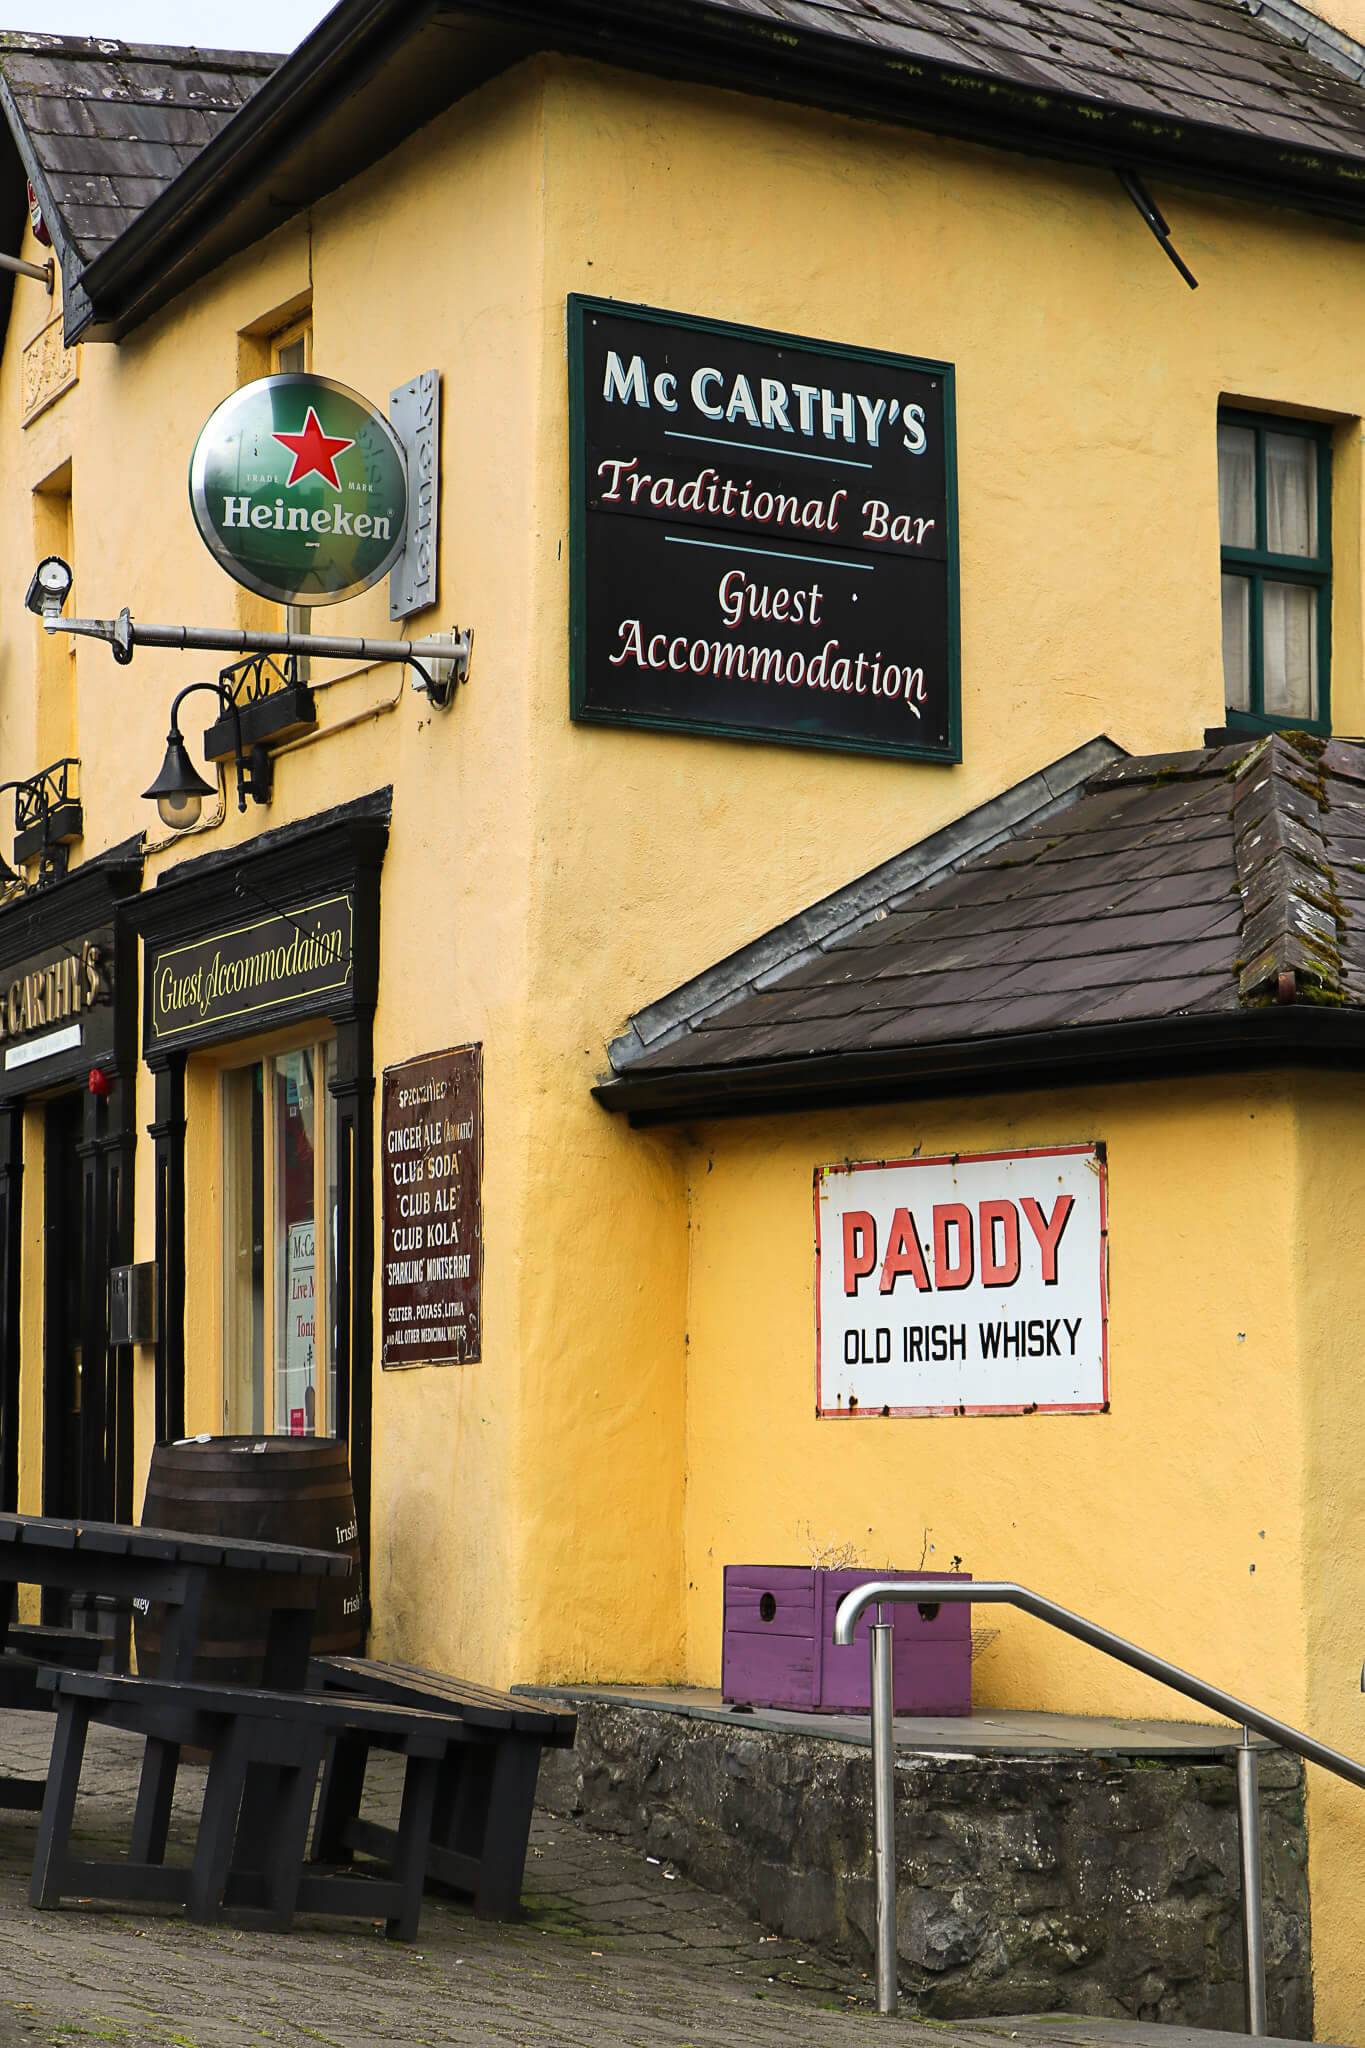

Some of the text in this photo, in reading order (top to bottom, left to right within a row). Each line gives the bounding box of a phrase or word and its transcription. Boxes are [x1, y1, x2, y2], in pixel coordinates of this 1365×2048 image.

[603, 351, 927, 454] Mc CARTHY'S
[247, 474, 374, 492] TRADE MARK
[597, 458, 935, 544] Traditional Bar
[222, 496, 392, 541] Heineken
[719, 570, 823, 628] Guest
[609, 620, 928, 702] Accommodation
[160, 921, 342, 1016] Guest Accommodation
[388, 1125, 421, 1153] GINGER
[423, 1122, 442, 1147] ALE
[427, 1254, 471, 1282] MONTSERRAT
[842, 1195, 1076, 1297] PADDY
[292, 1277, 308, 1300] Live
[395, 1330, 404, 1345] ALL
[404, 1328, 420, 1344] OTHER
[421, 1327, 447, 1342] MEDICINAL
[844, 1318, 1082, 1365] OLD IRISH WHISKY
[336, 1520, 357, 1545] Irish
